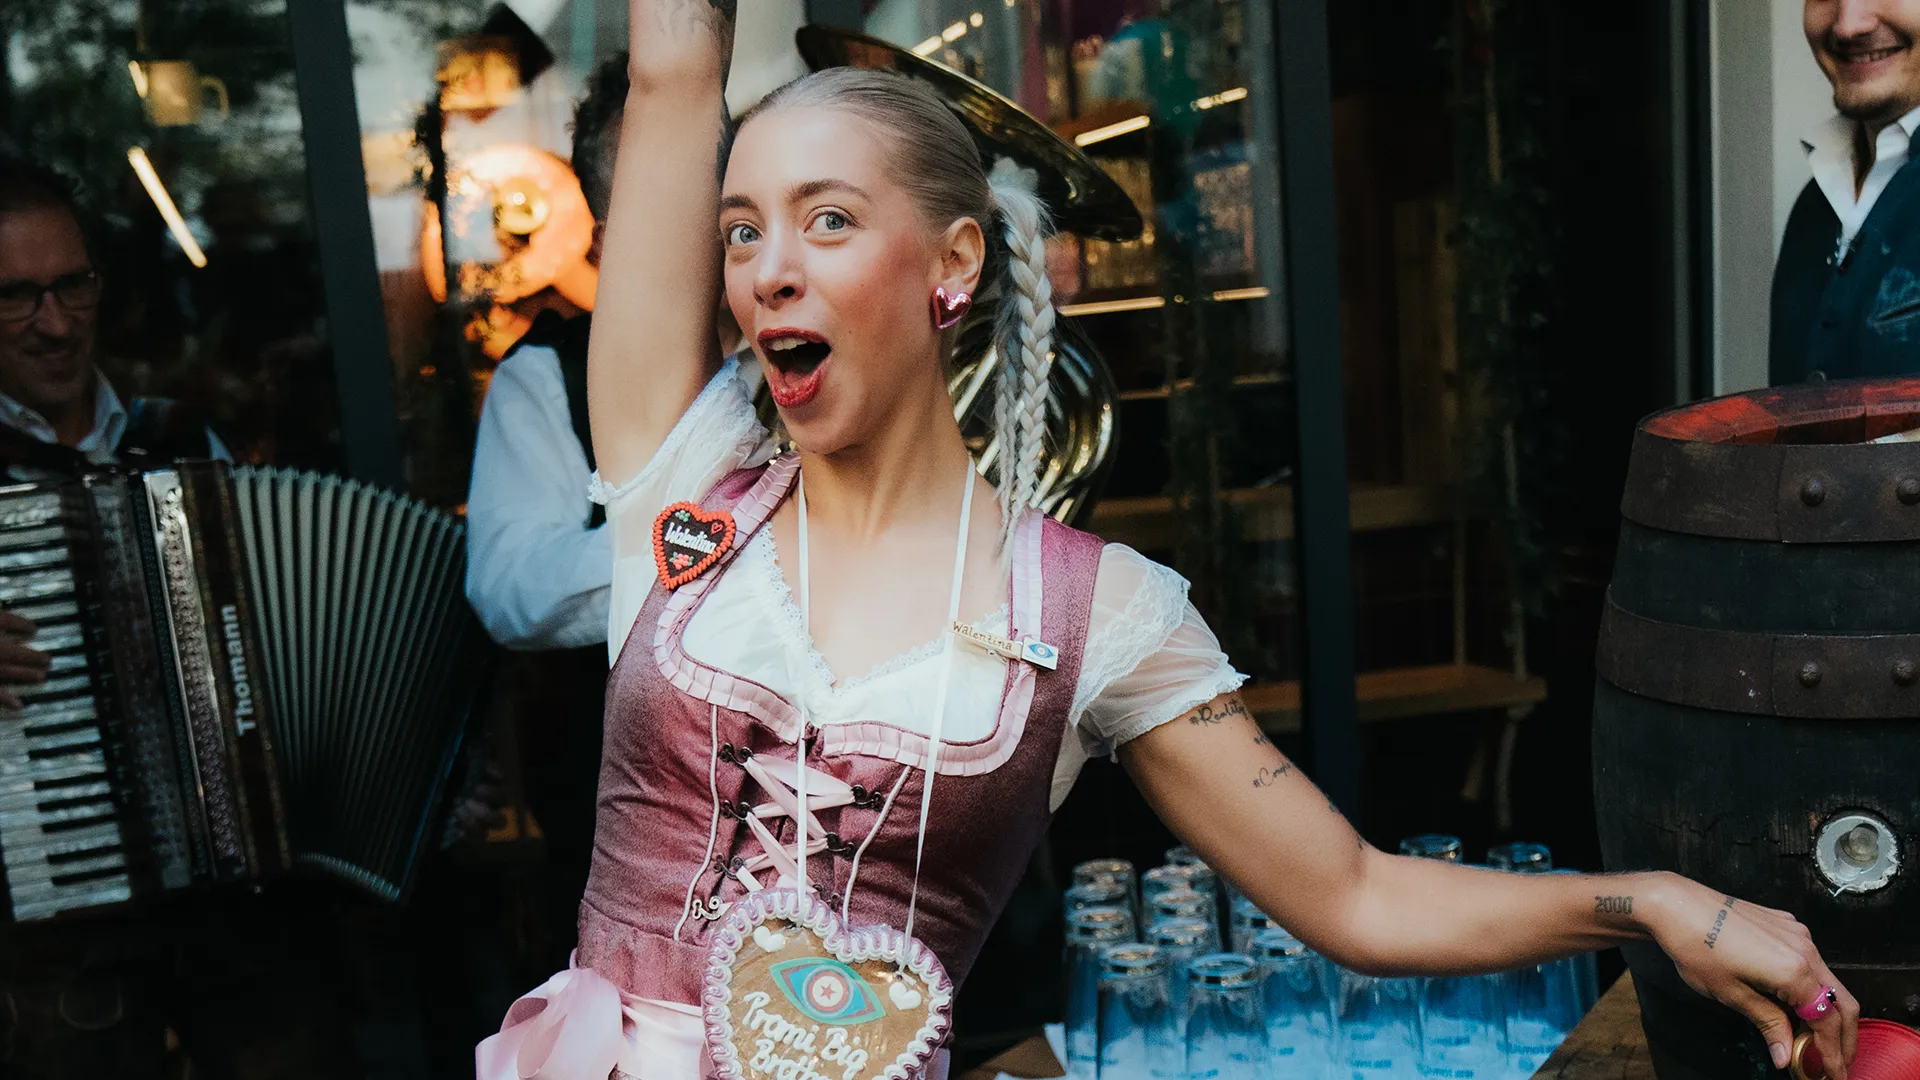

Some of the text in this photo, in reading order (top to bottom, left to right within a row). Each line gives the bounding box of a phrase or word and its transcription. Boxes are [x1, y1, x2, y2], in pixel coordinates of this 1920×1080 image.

[221, 604, 256, 736] Thomann
[1595, 896, 1633, 915] 2000
[1704, 909, 1728, 949] energy
[743, 991, 868, 1080] Promi Big
